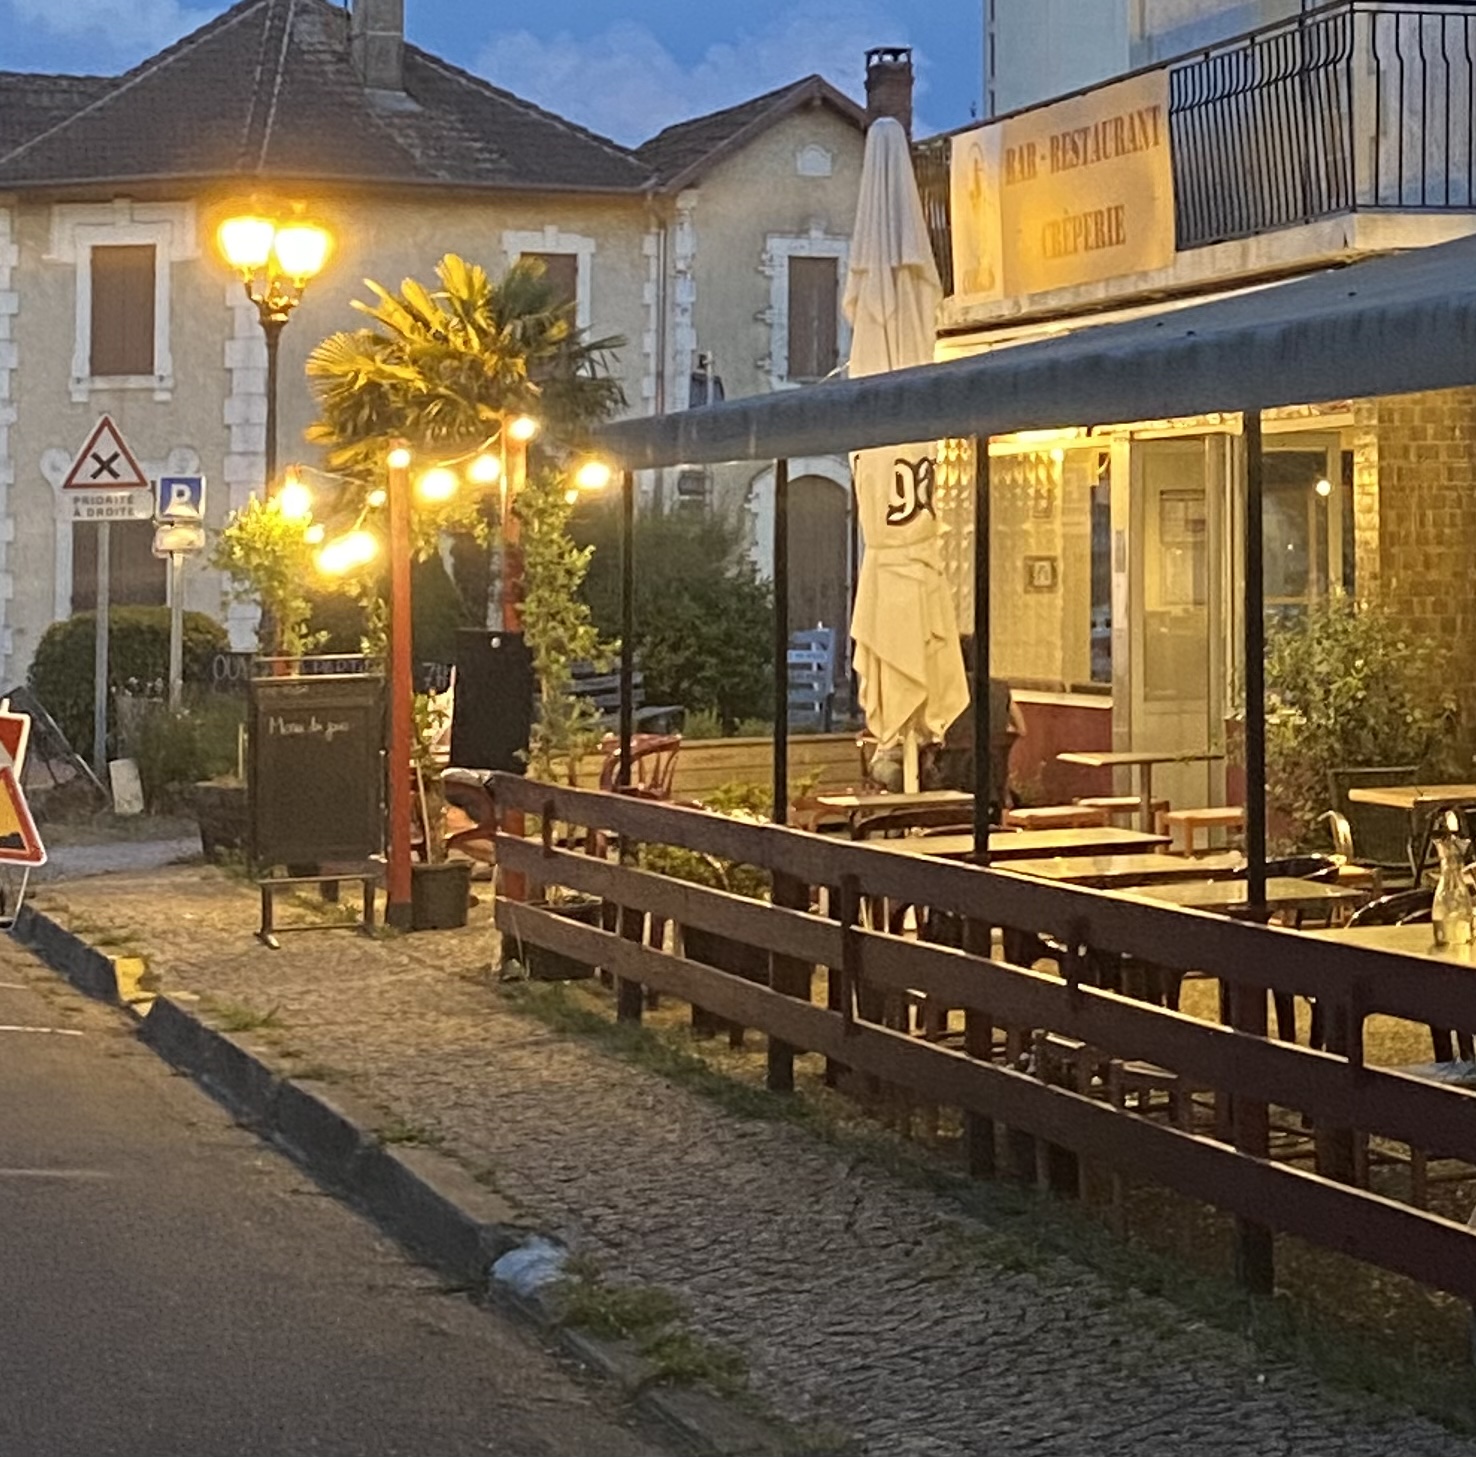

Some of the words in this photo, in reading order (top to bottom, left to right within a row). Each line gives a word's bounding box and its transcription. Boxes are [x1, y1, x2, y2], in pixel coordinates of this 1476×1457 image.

[1005, 141, 1038, 185] BAR
[1049, 104, 1162, 175] RESTAURANT
[171, 483, 192, 503] P
[86, 506, 135, 517] DROITE
